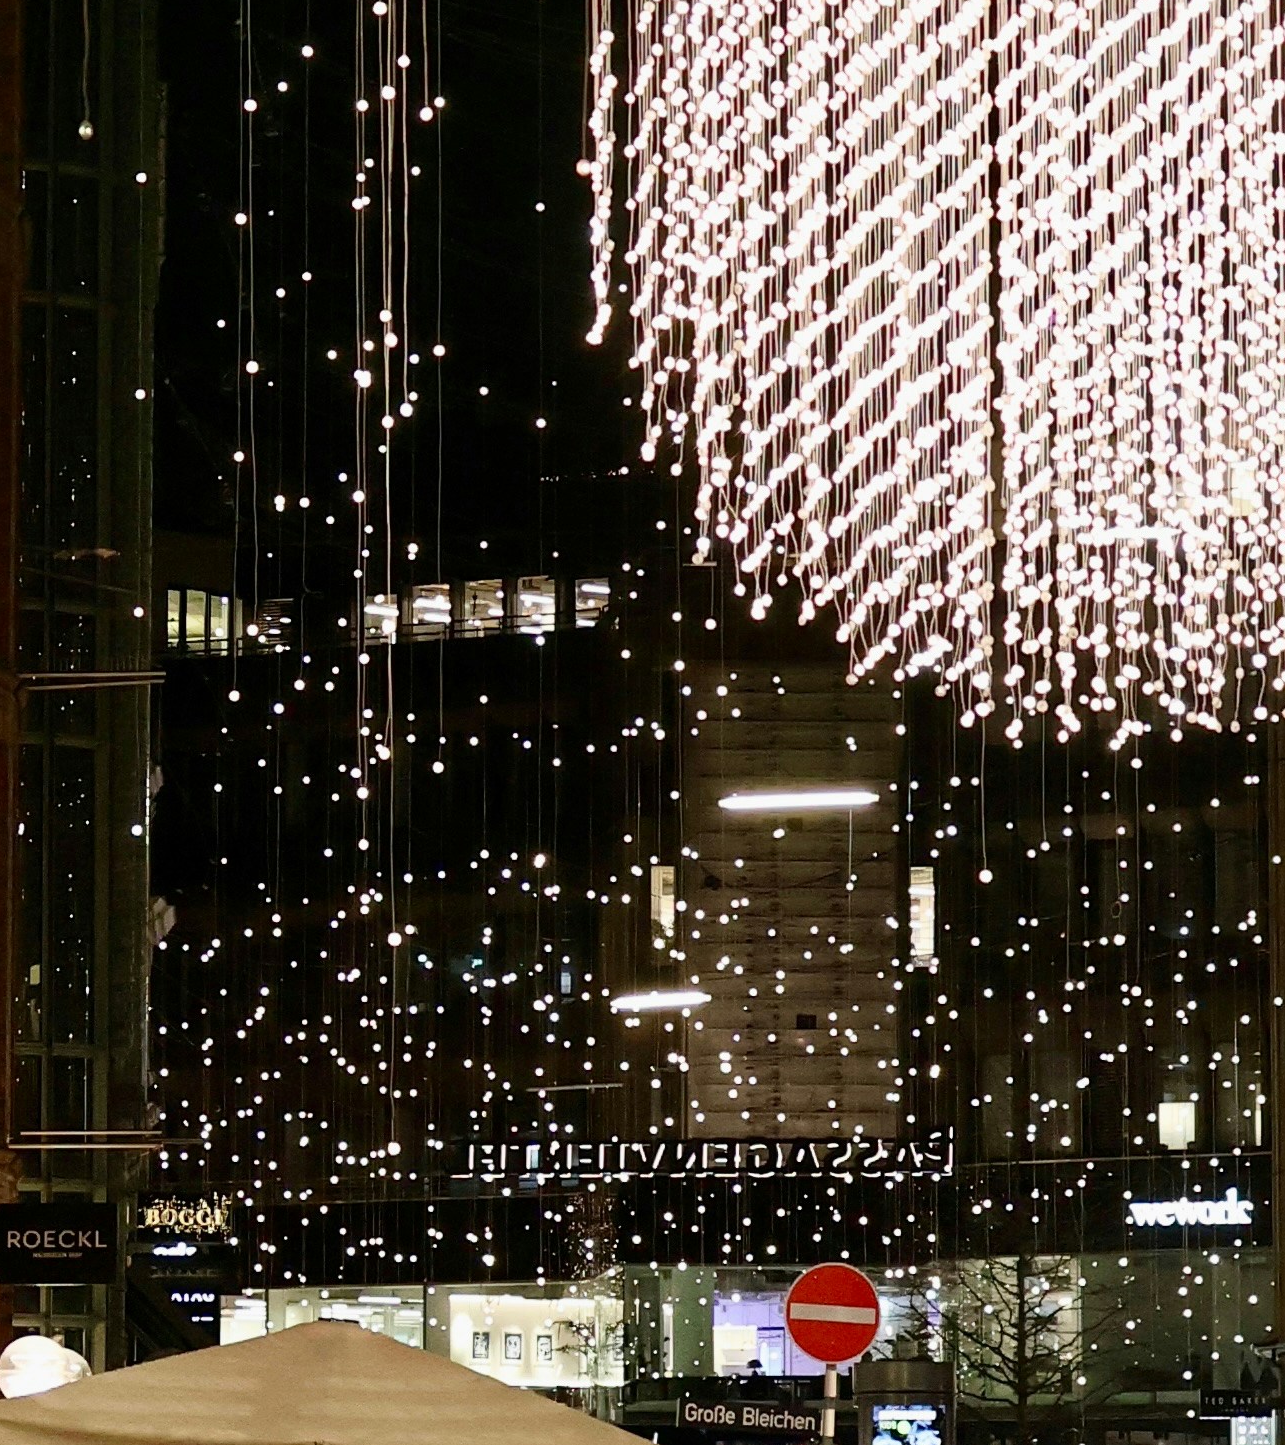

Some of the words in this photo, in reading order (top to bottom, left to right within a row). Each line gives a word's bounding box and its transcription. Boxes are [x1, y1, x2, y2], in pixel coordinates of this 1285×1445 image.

[1128, 1187, 1255, 1227] wework
[6, 1229, 108, 1249] ROECKL
[684, 1402, 736, 1426] Große
[742, 1406, 816, 1431] Bleichen
